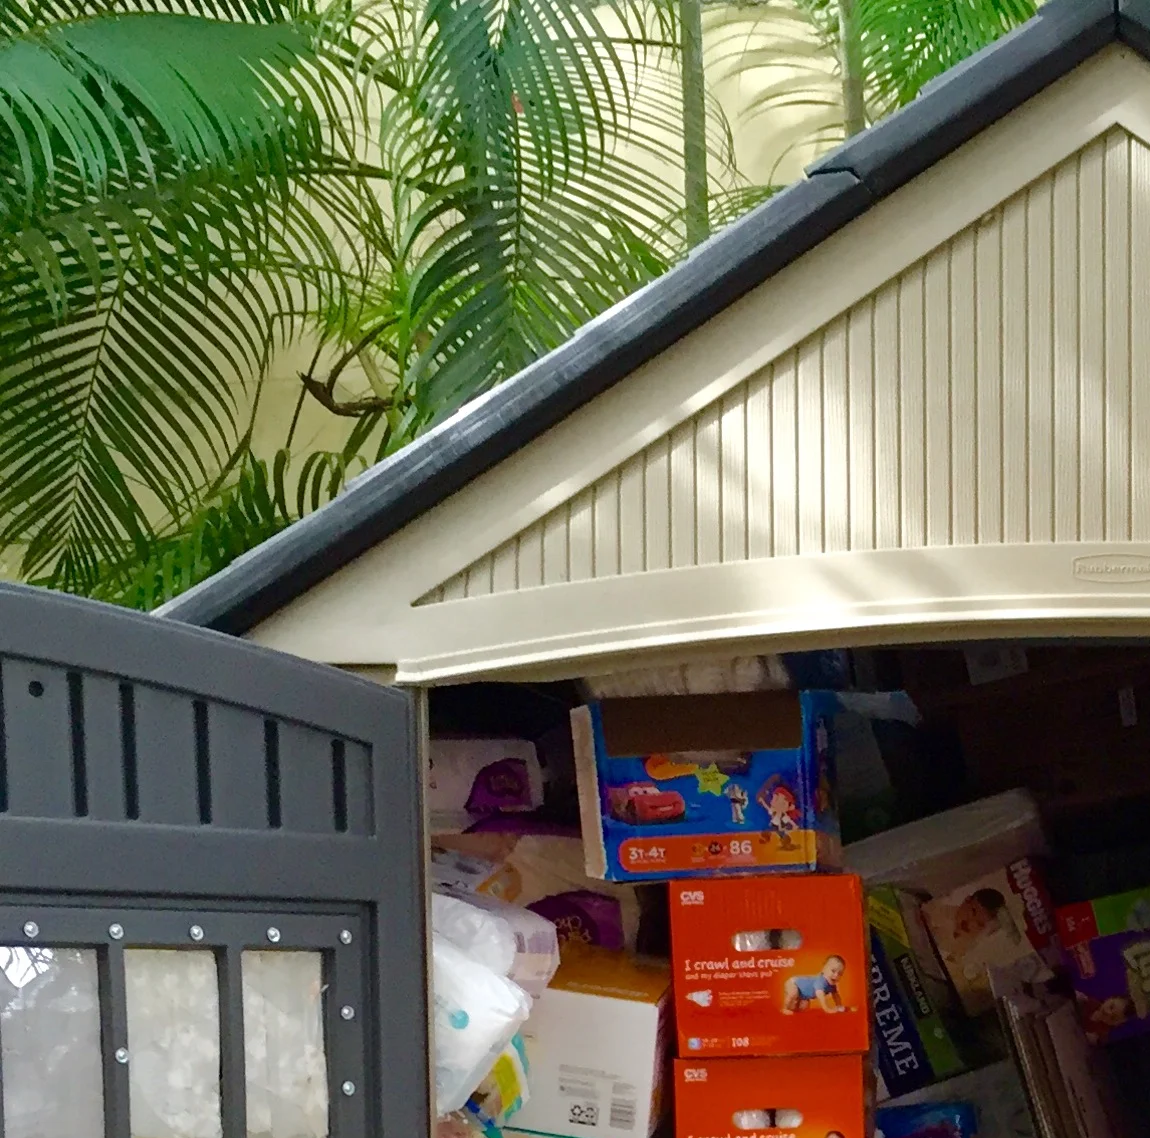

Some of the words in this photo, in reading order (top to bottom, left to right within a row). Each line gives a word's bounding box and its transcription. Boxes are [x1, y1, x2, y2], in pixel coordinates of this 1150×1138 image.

[729, 841, 752, 855] 86
[680, 890, 704, 900] CVS
[685, 960, 691, 972] I
[694, 958, 729, 971] crawl
[732, 956, 755, 969] and
[757, 956, 795, 968] cruise
[731, 1037, 750, 1048] 108
[684, 1069, 707, 1078] CVS
